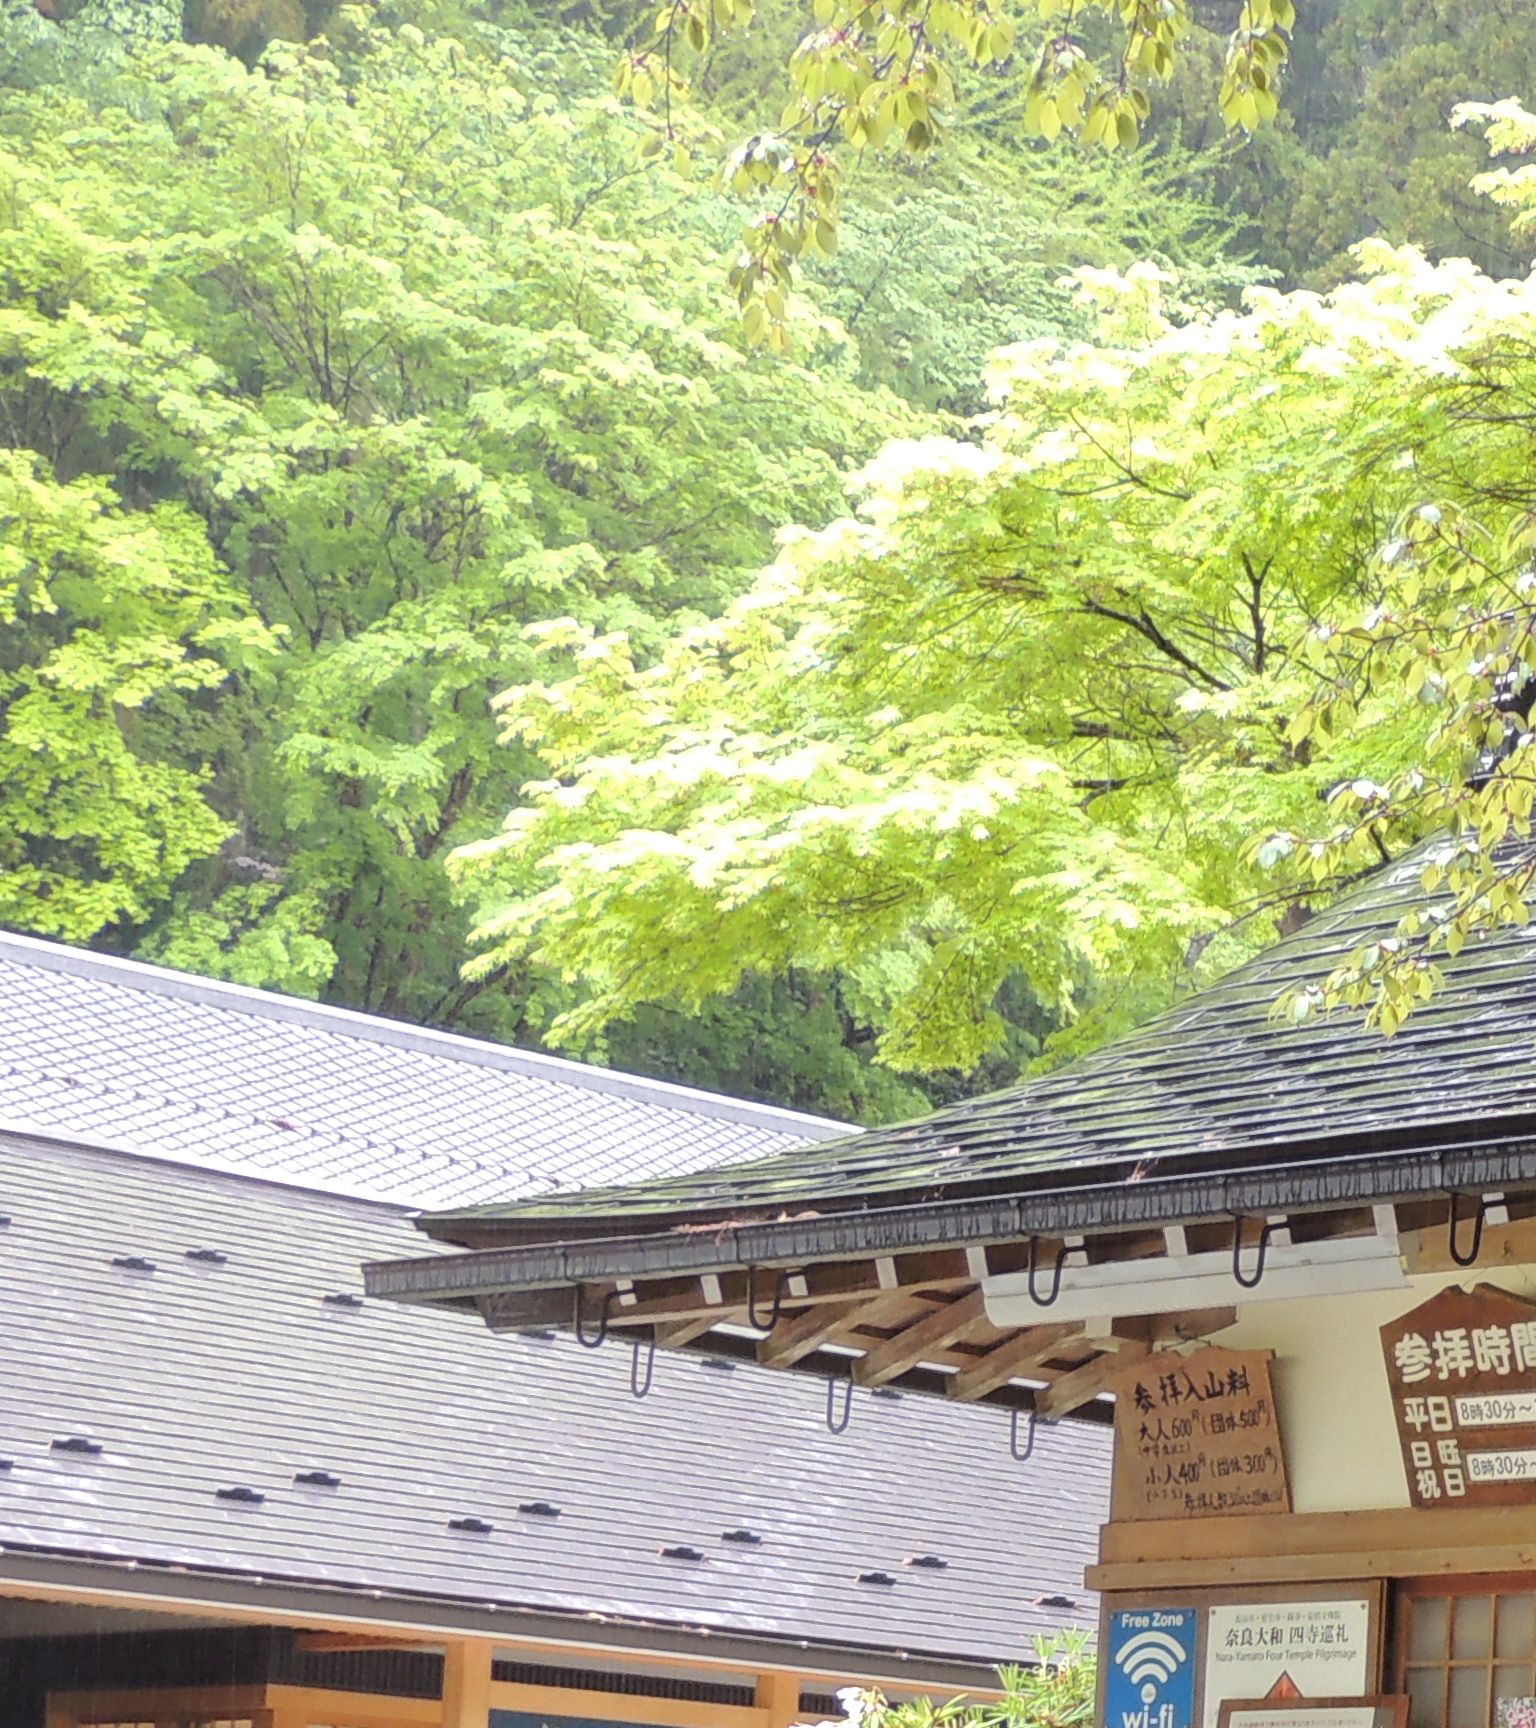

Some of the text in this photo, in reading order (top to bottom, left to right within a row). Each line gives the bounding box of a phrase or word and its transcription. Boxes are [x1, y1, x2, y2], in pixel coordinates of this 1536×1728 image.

[1134, 1365, 1250, 1414] 参拝入山料
[1403, 1396, 1453, 1432] 平日
[1416, 1468, 1466, 1499] 祝日
[1122, 1611, 1184, 1628] Free Zone
[1225, 1623, 1349, 1647] 奈良大和 四寺巡礼
[1265, 1650, 1283, 1661] Four
[1284, 1649, 1314, 1662] Temple
[1315, 1648, 1357, 1661] Pilgrimage
